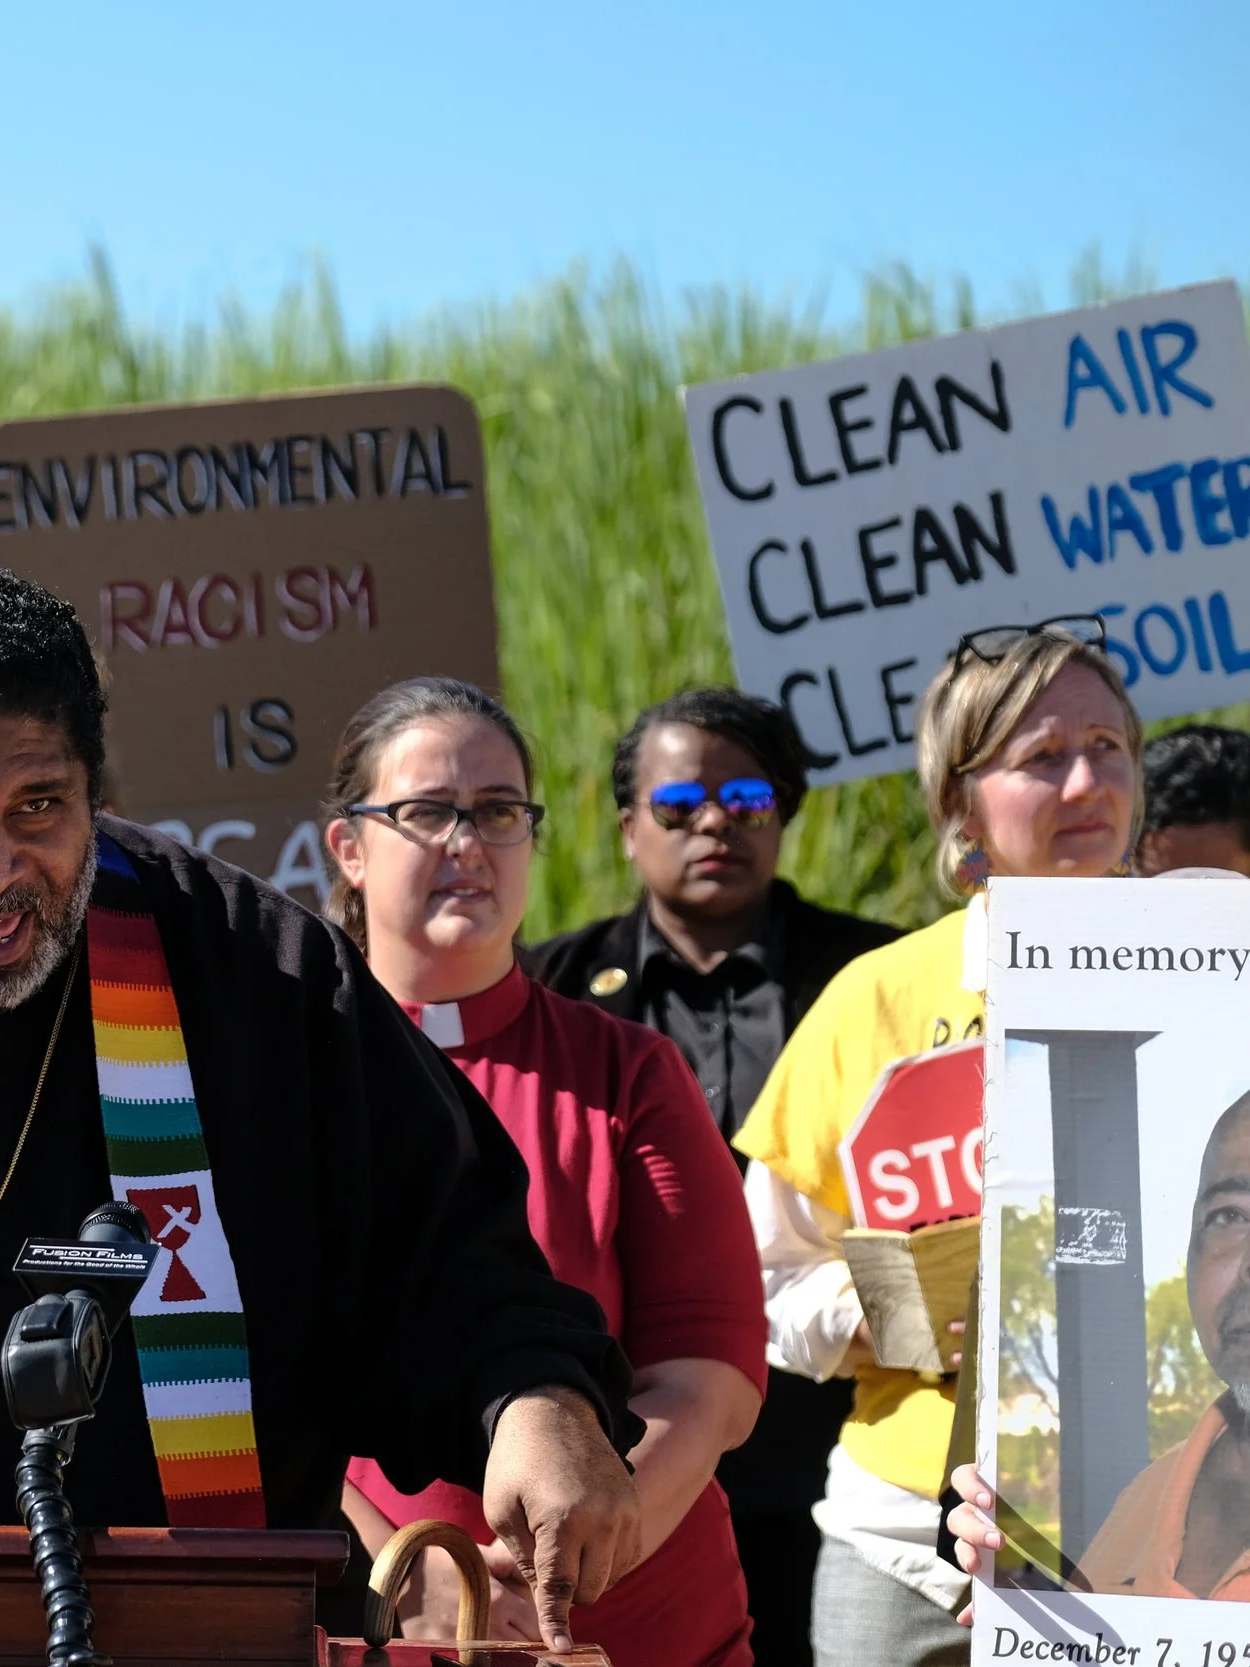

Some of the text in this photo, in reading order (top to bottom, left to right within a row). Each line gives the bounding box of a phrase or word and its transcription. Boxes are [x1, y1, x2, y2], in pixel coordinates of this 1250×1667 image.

[712, 320, 1214, 502] CLEAN AIR
[748, 456, 1250, 635] CLEAN WATER
[98, 564, 379, 654] RACISM
[780, 590, 1250, 769] CLE SOIL
[212, 698, 298, 774] IS
[1005, 931, 1250, 982] In memory
[869, 1126, 984, 1220] ST
[32, 1248, 143, 1260] FUSION FILMS
[992, 1626, 1141, 1665] December
